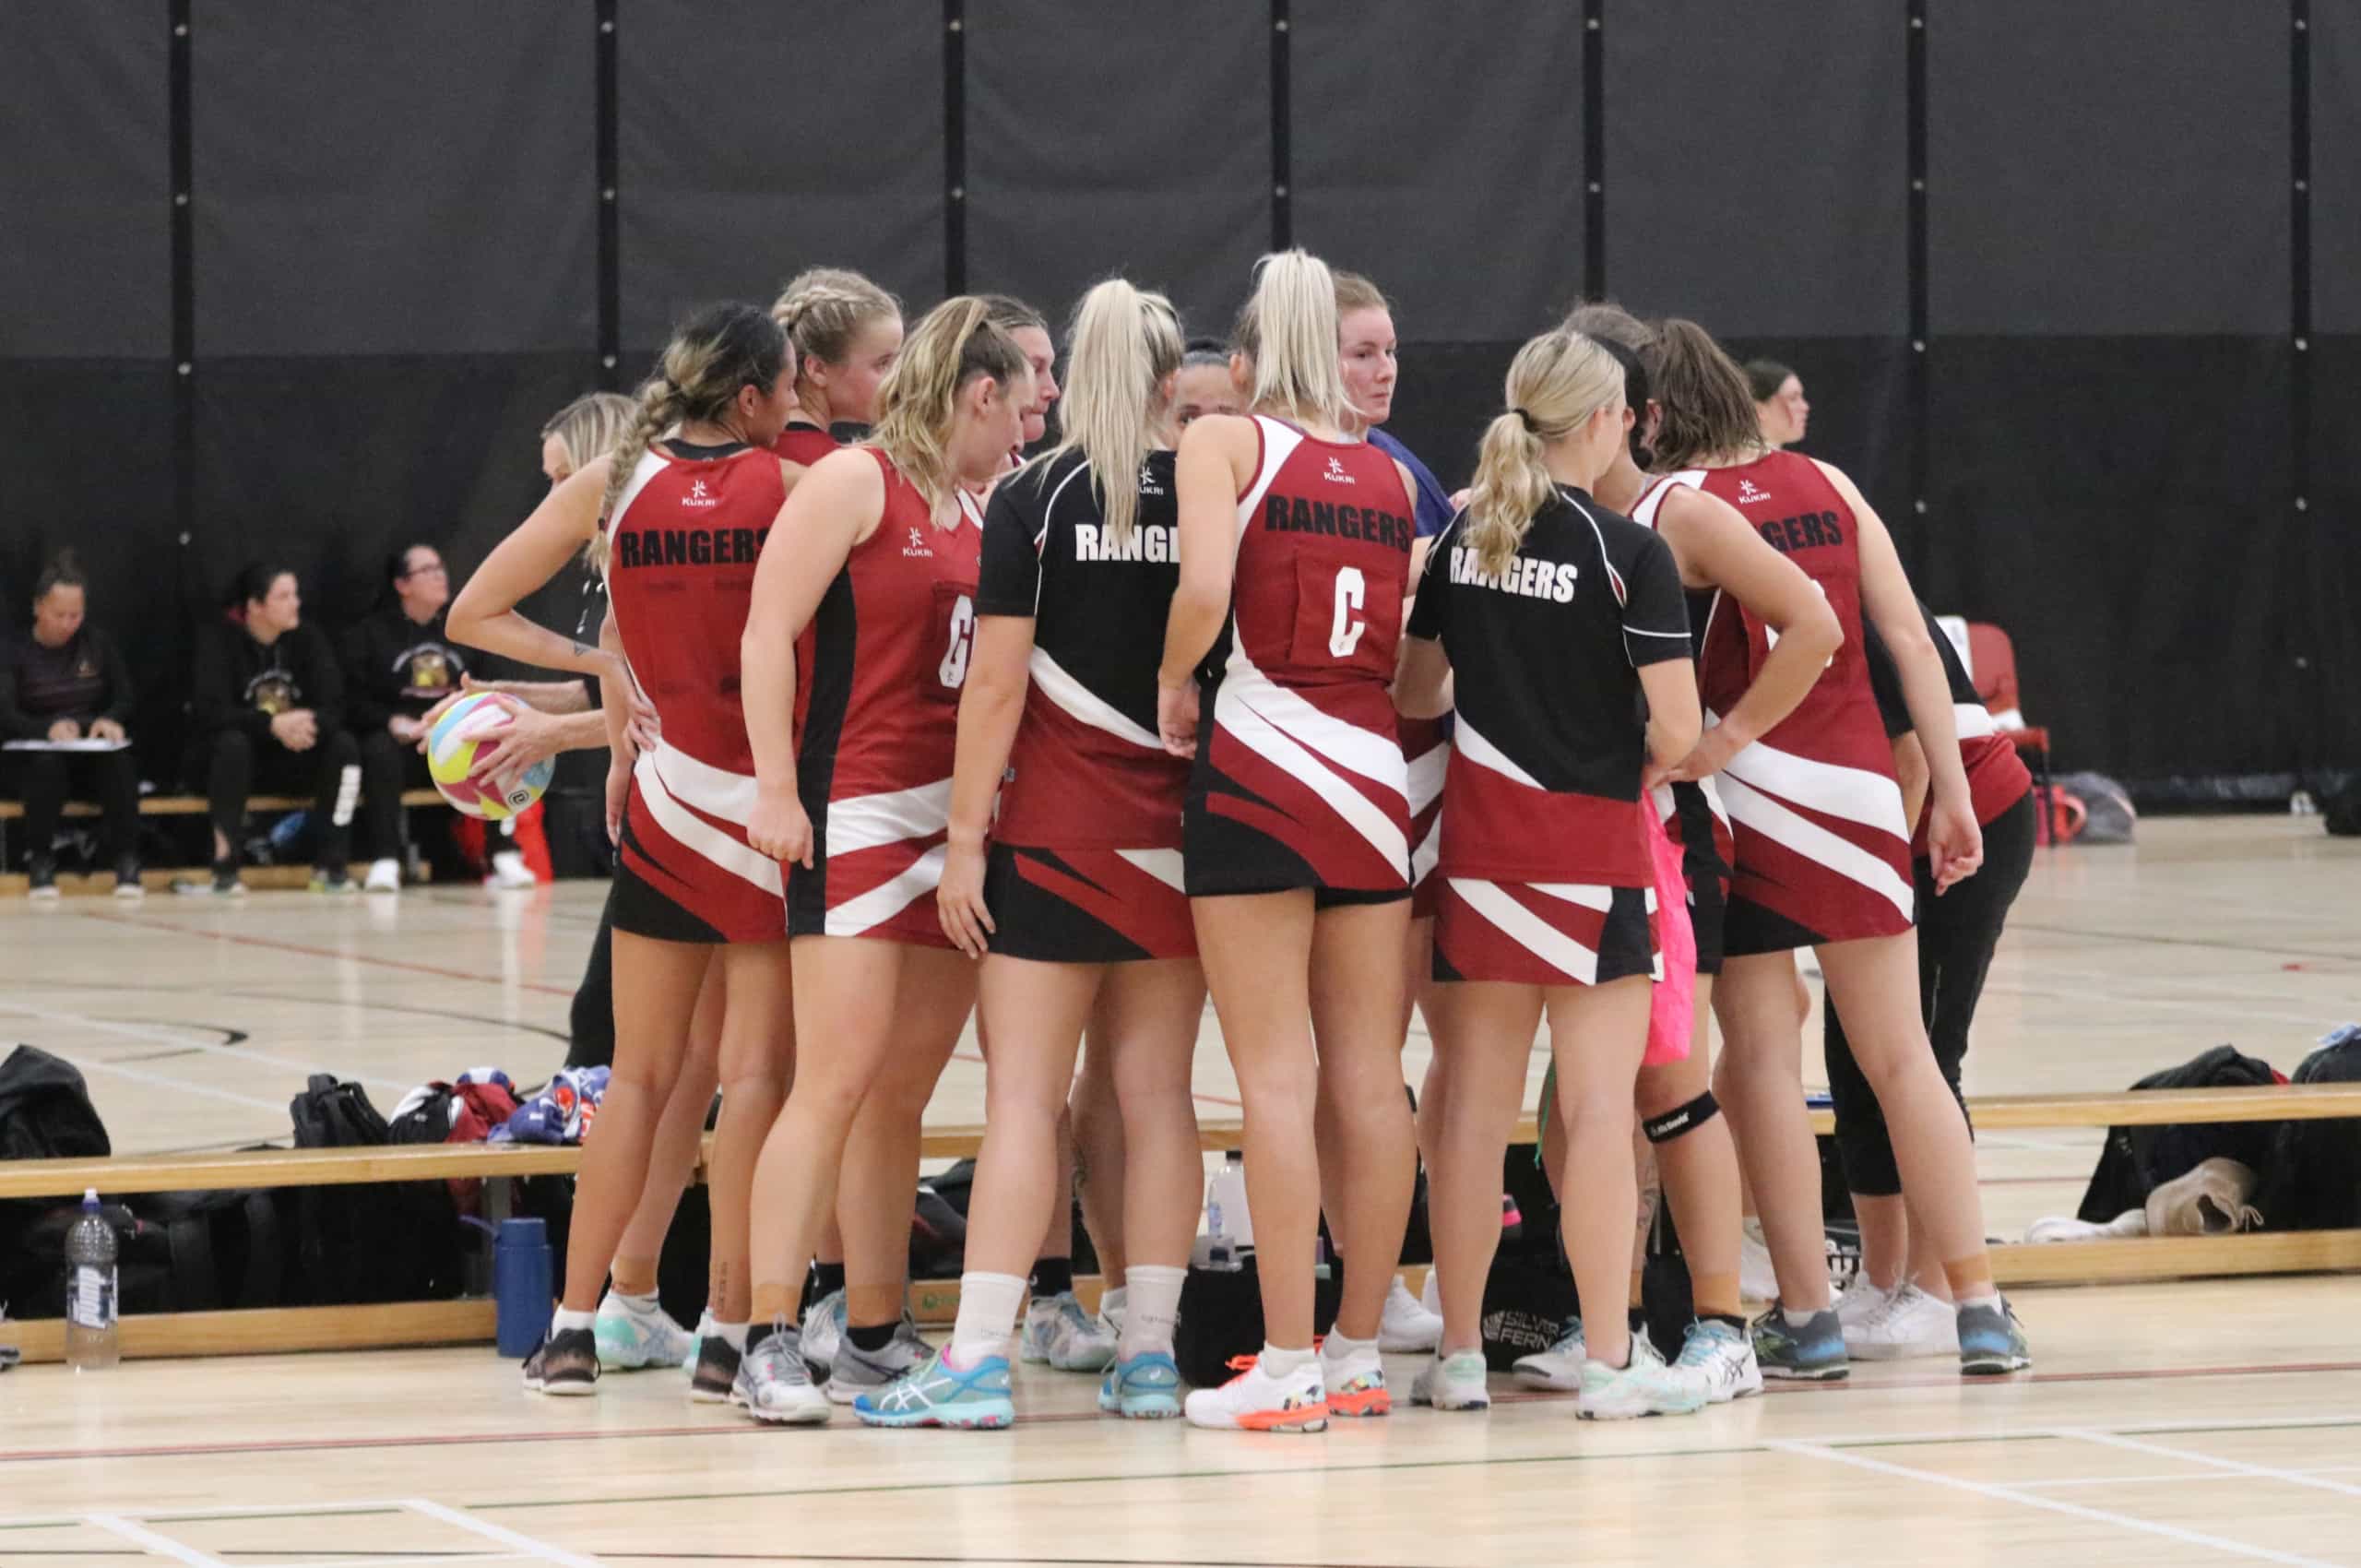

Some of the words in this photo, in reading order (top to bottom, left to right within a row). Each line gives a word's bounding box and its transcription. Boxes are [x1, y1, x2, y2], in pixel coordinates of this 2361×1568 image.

[1139, 486, 1164, 495] UKRI
[1265, 493, 1411, 553] RANGERS
[1754, 510, 1844, 552] GERS
[1329, 566, 1365, 657] C
[1500, 1326, 1551, 1349] FERN
